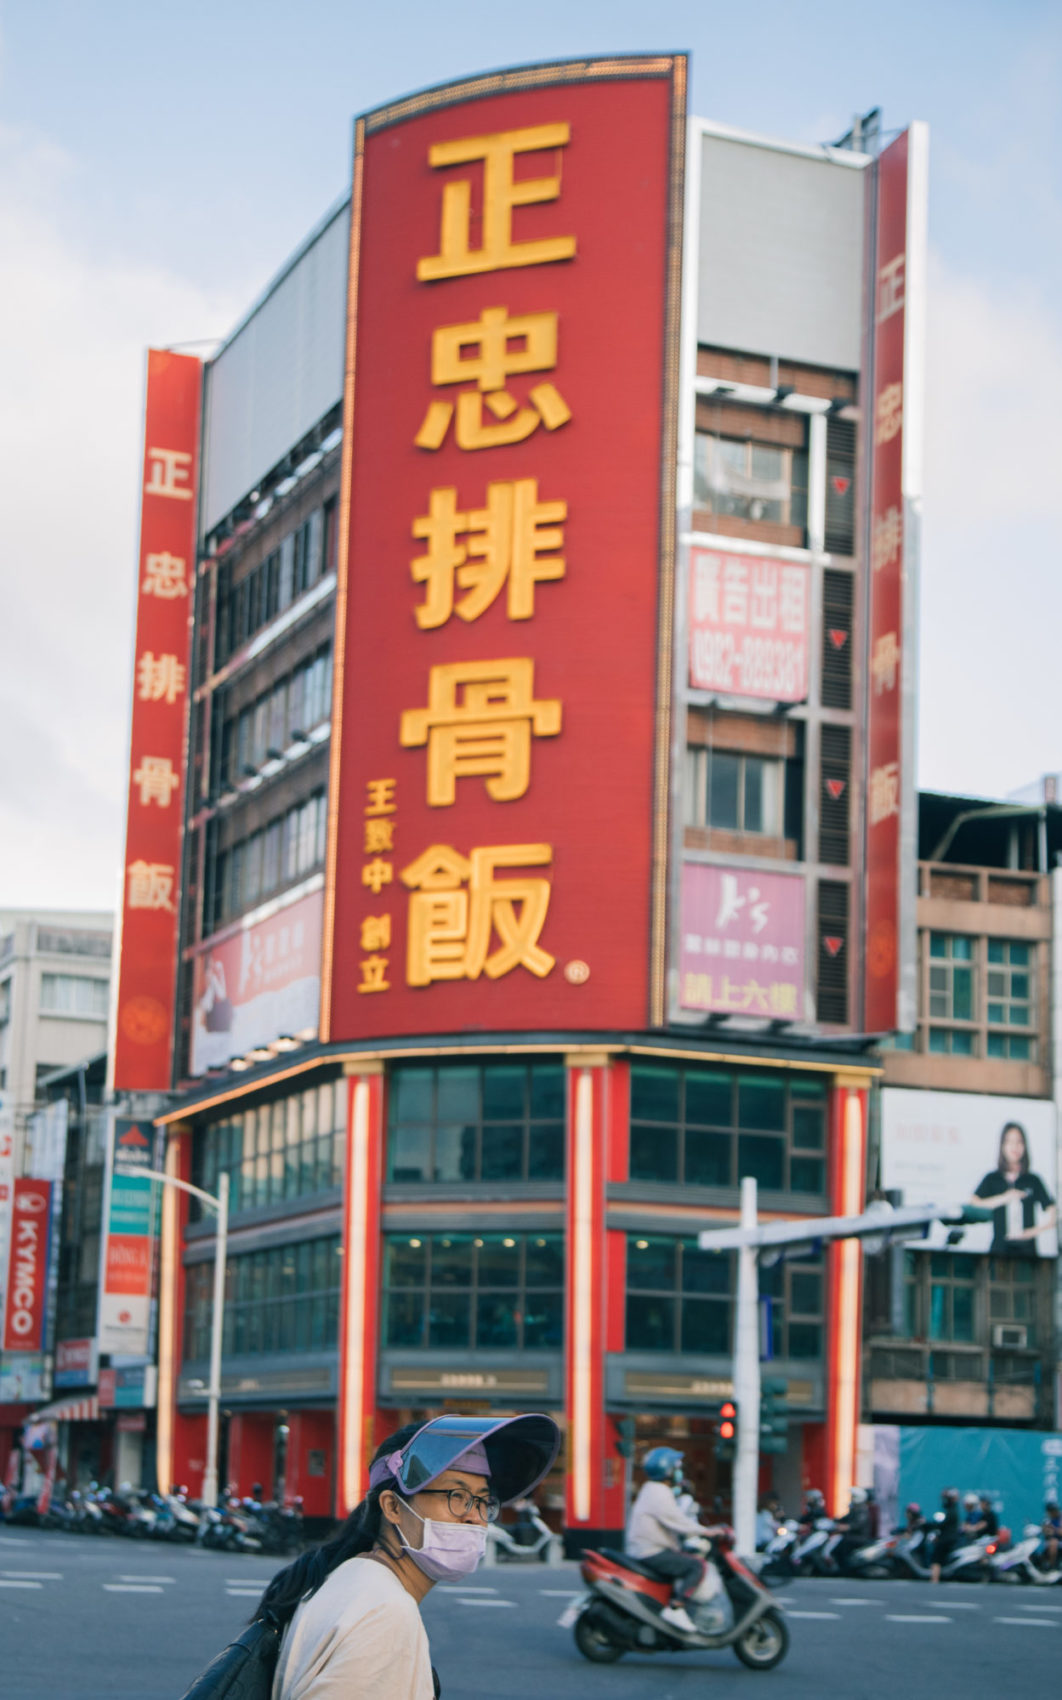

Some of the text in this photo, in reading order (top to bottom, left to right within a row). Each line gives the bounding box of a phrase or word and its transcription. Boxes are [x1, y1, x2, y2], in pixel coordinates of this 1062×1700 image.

[127, 446, 194, 912] 正忠排骨飯
[399, 121, 578, 987] 正忠排骨飯
[11, 1219, 38, 1336] KYMCO
